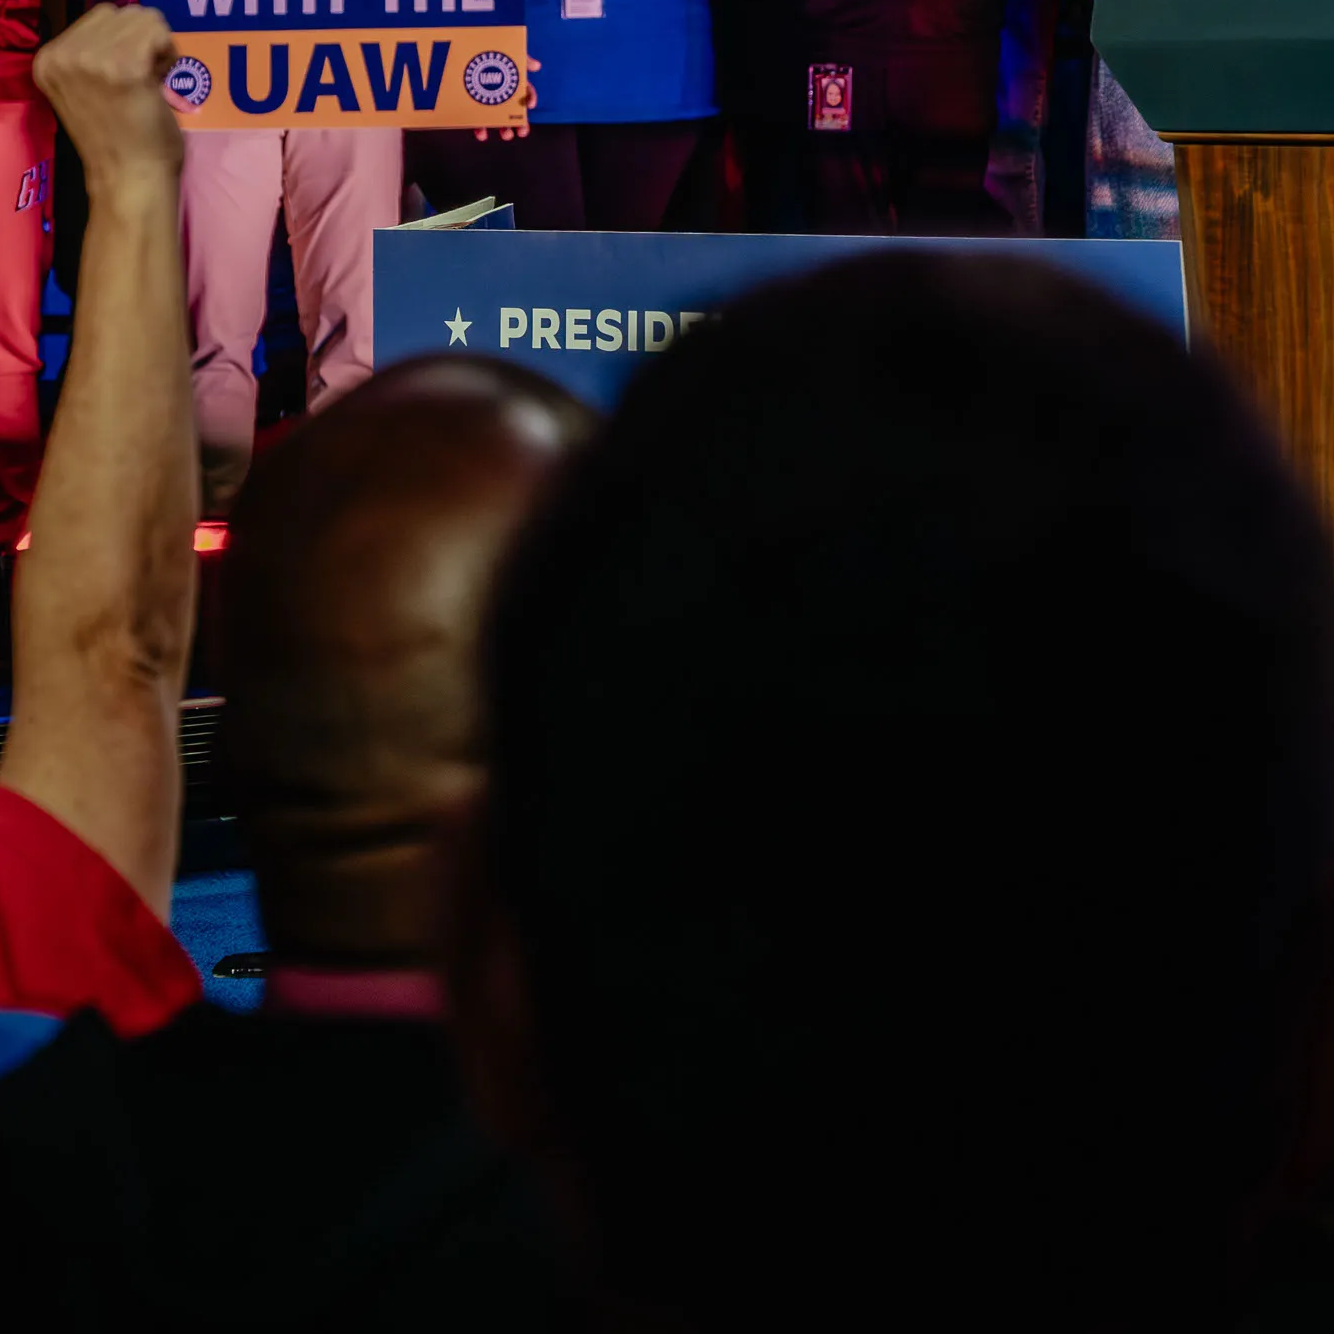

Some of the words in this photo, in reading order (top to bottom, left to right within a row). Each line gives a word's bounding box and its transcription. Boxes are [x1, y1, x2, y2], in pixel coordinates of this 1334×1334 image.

[171, 75, 195, 91] UAW
[228, 40, 452, 115] UAW
[479, 70, 504, 85] UAW
